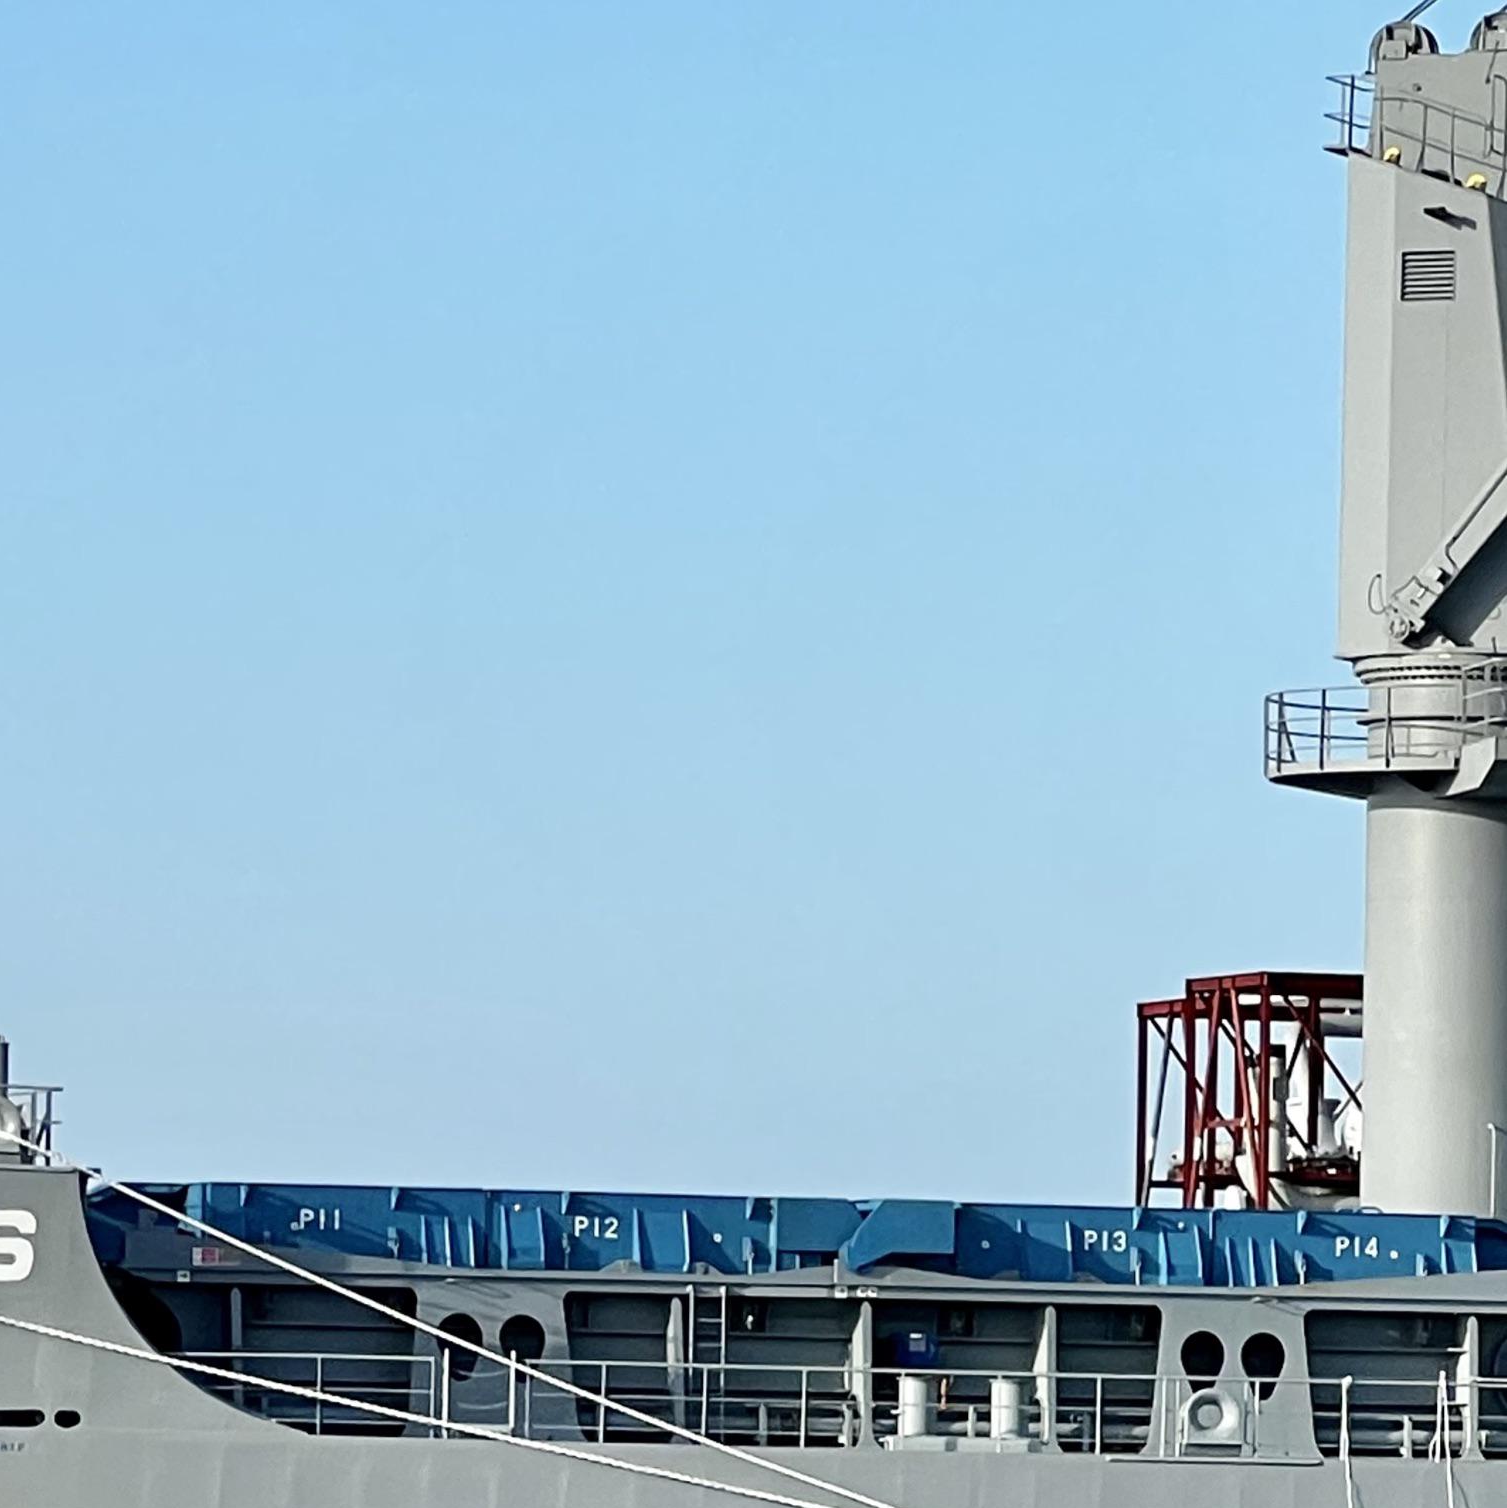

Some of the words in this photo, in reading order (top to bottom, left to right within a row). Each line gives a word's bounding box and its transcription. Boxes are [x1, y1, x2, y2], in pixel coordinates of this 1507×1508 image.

[299, 1208, 340, 1230] P11
[574, 1215, 619, 1239] P12
[1083, 1229, 1127, 1252] P13
[1335, 1235, 1379, 1258] P14
